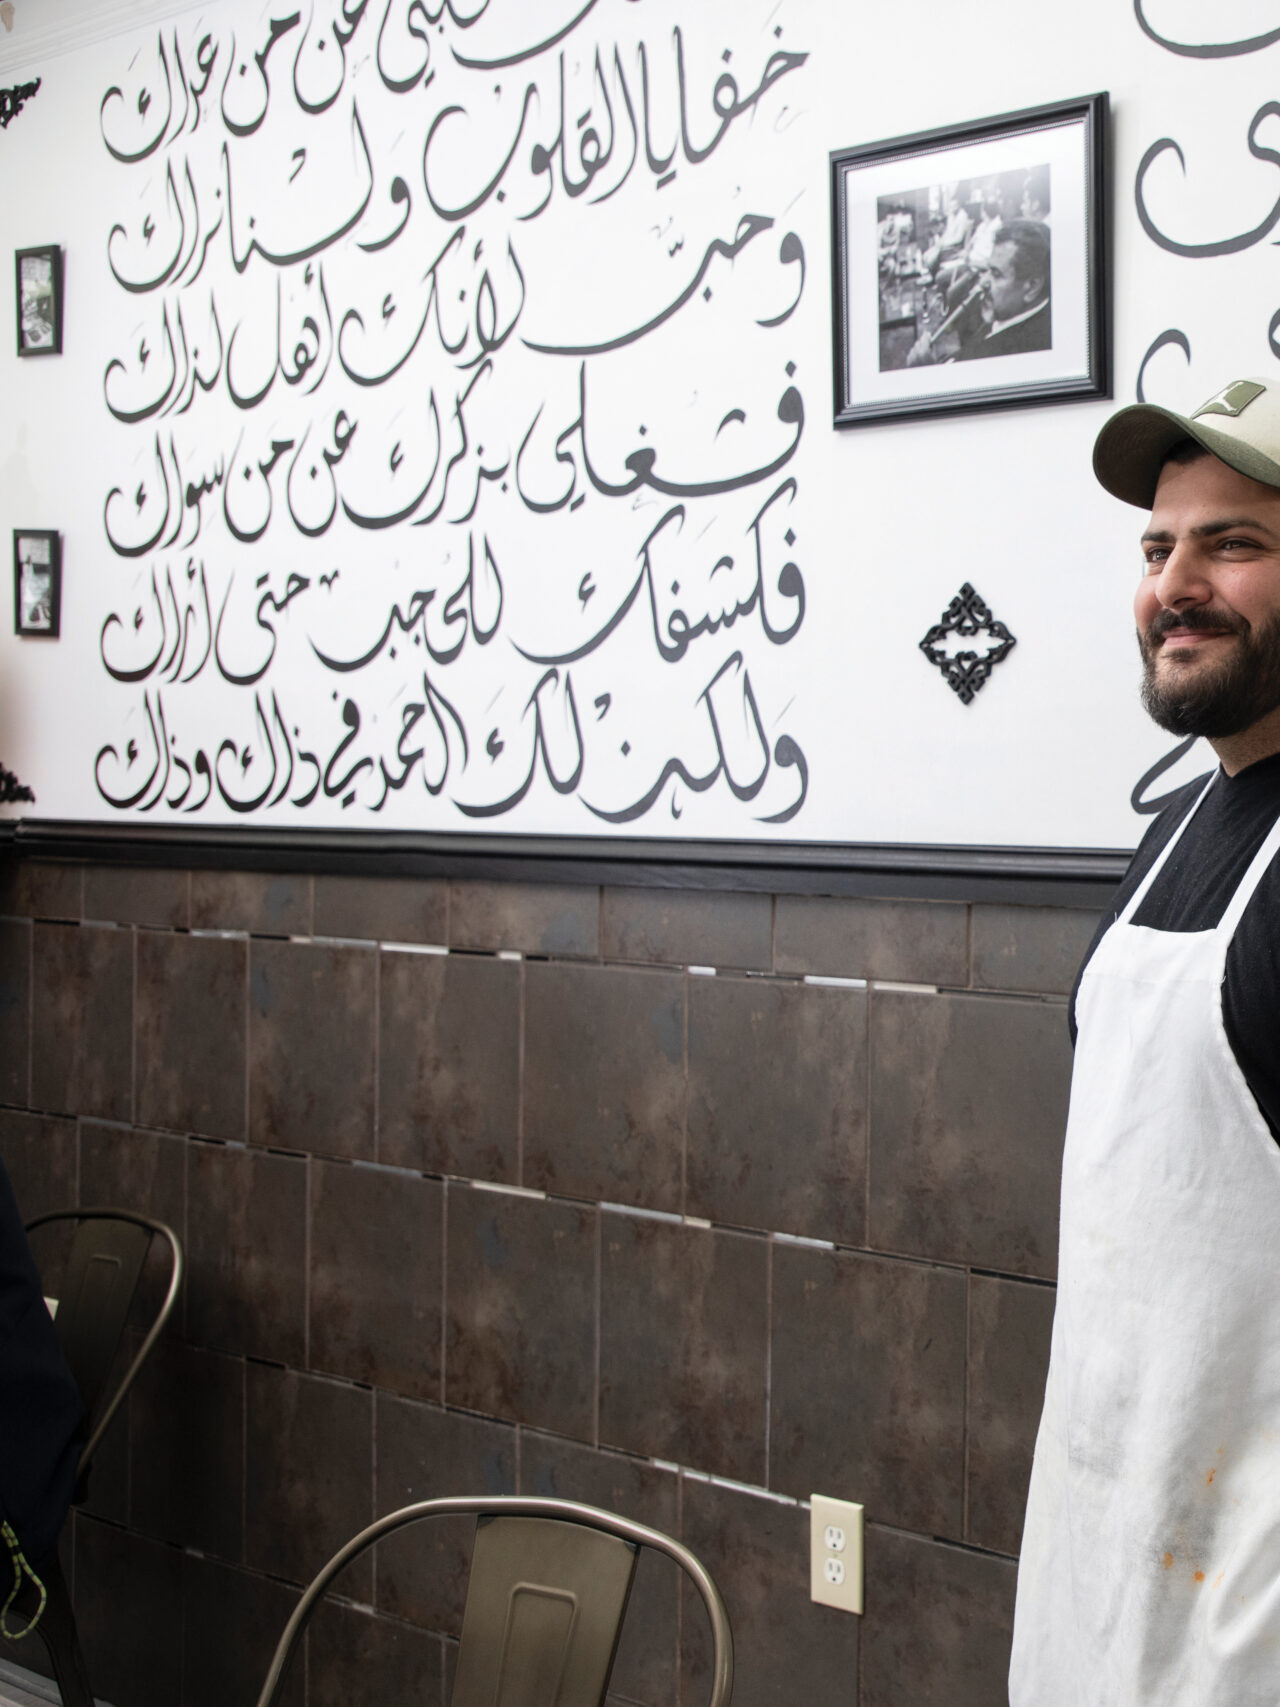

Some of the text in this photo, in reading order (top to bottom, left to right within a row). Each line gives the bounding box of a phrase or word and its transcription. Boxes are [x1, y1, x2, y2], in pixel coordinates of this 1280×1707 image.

[221, 8, 301, 136] من
[424, 42, 636, 222] القلوب
[638, 24, 810, 190] خفايا
[224, 426, 295, 543] من
[323, 690, 374, 810] في
[450, 667, 584, 818] لك
[578, 650, 809, 824] ولكن
